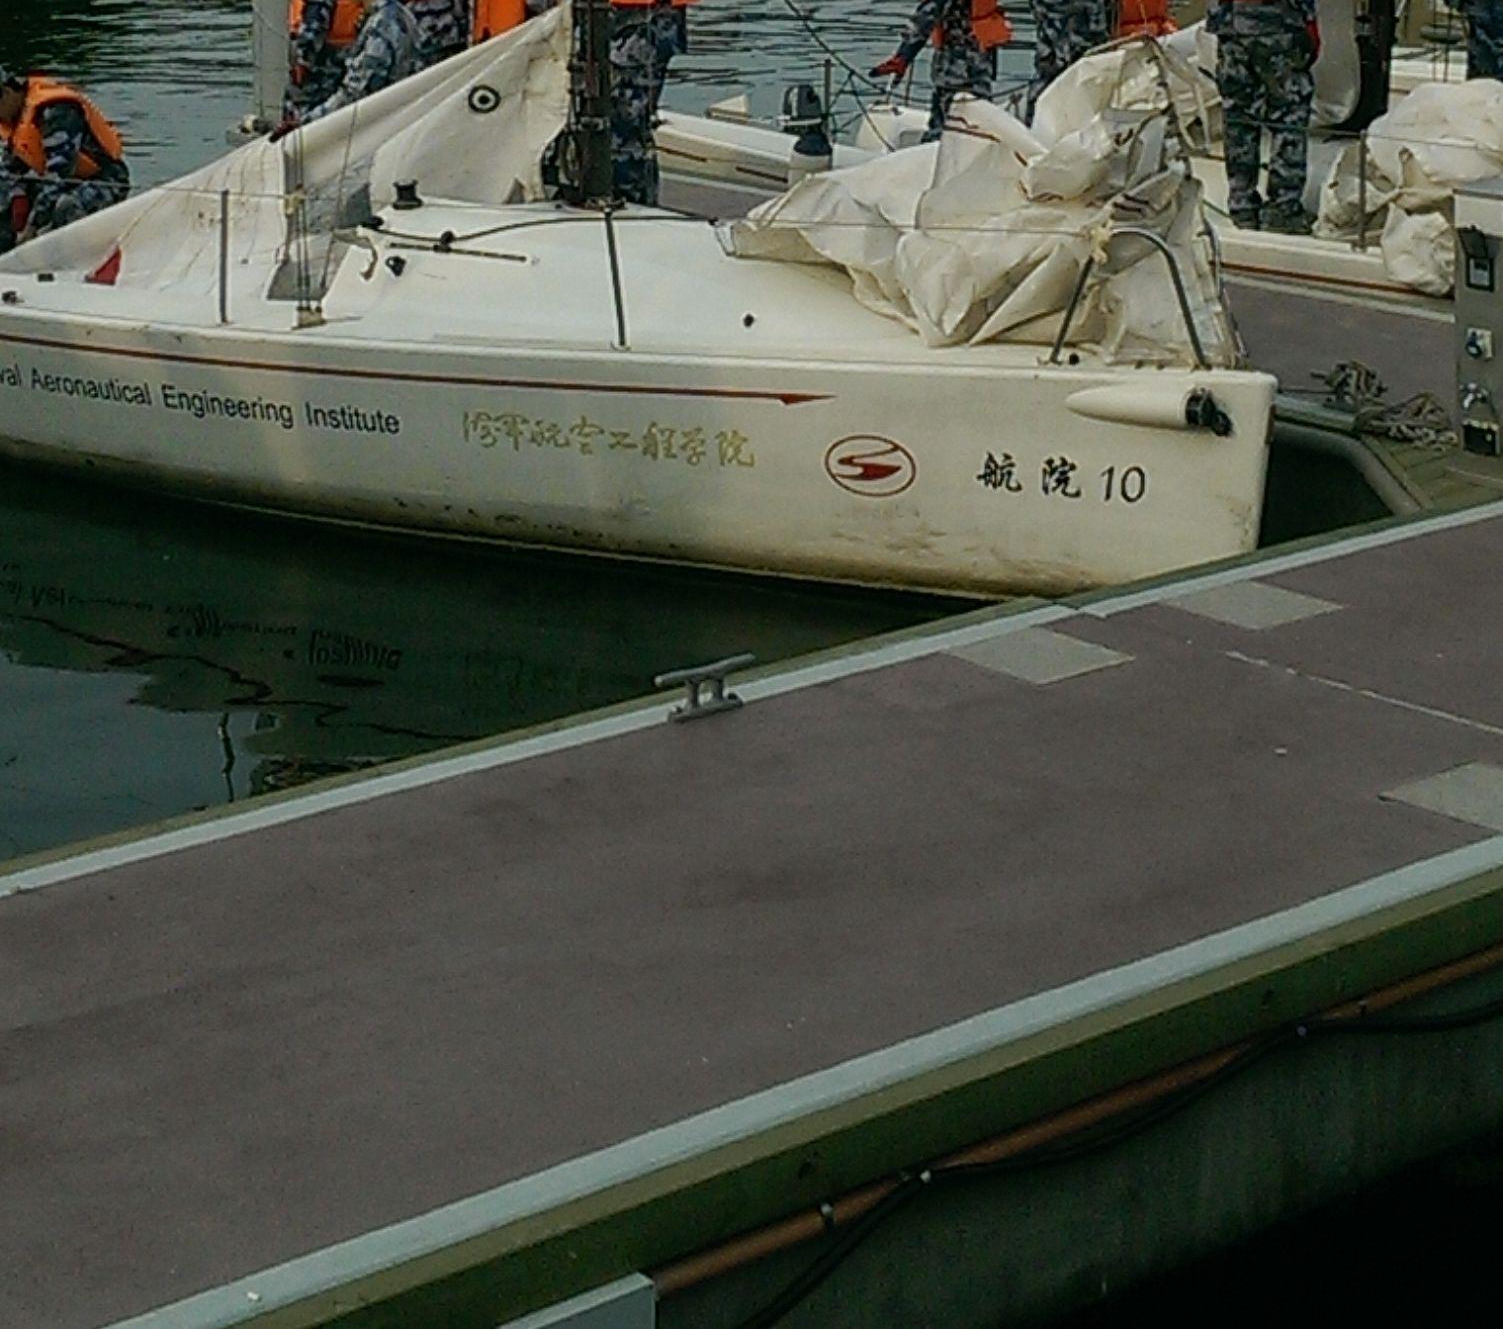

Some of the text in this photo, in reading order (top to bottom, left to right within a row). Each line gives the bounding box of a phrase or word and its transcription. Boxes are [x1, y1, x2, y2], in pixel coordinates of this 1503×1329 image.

[31, 367, 151, 406] Aeronautical
[161, 383, 293, 430] Engineering
[305, 400, 400, 434] Institute
[1100, 466, 1146, 503] 10
